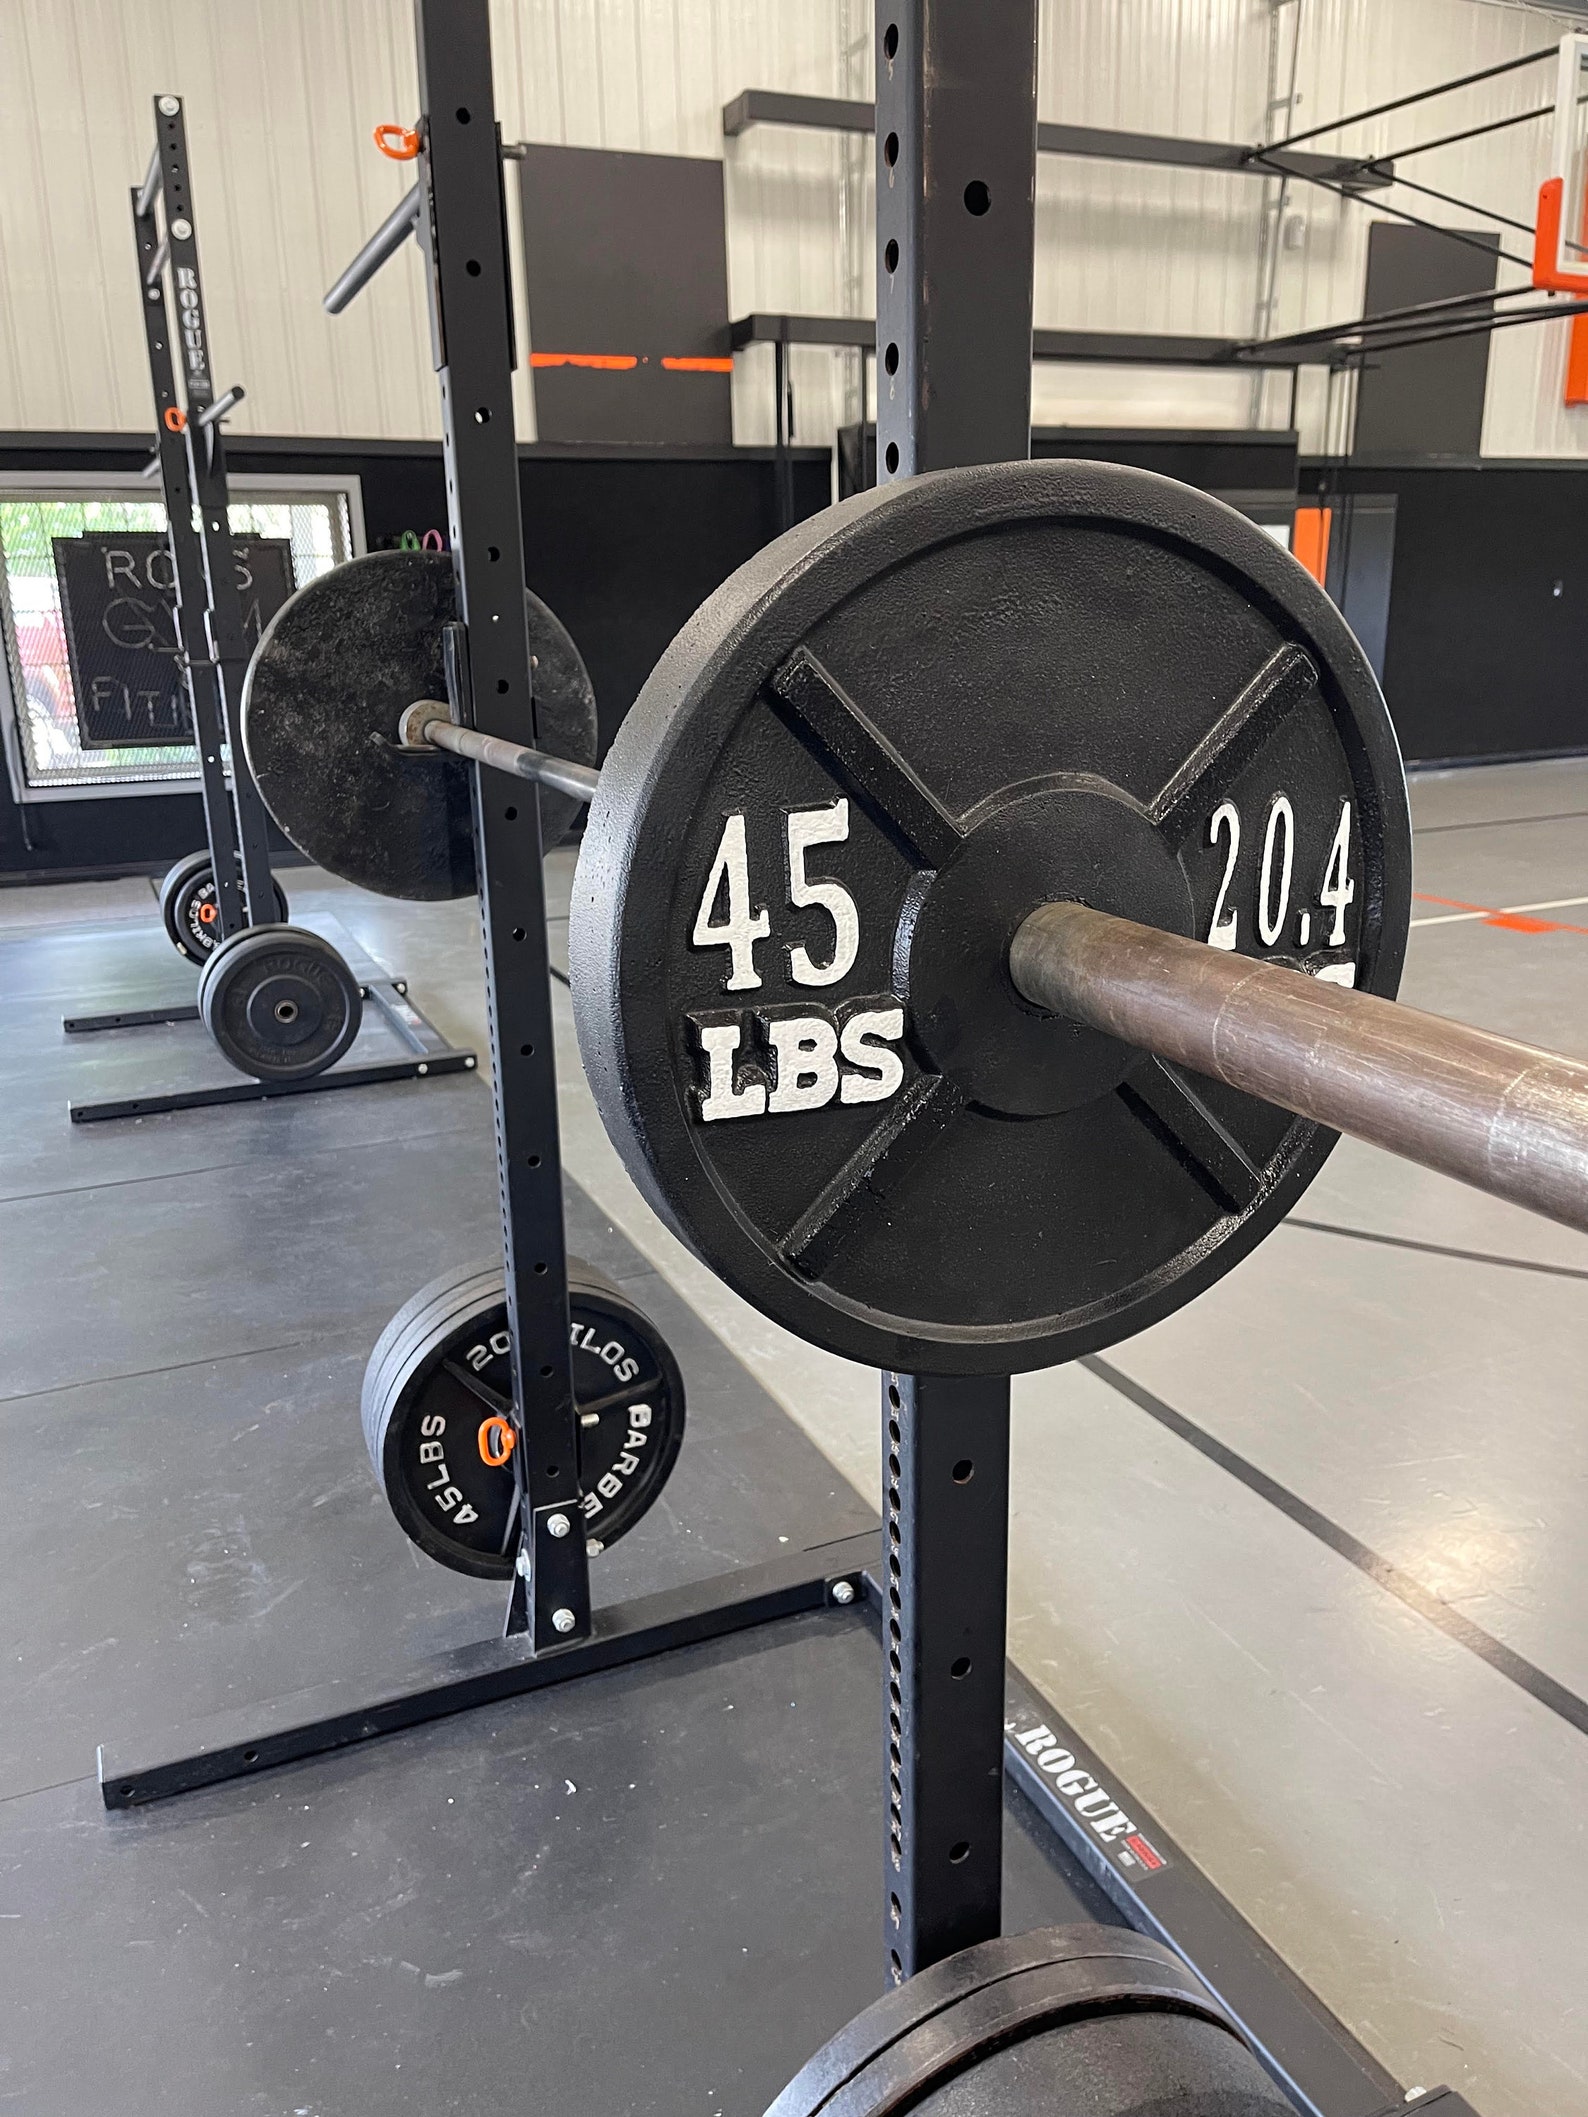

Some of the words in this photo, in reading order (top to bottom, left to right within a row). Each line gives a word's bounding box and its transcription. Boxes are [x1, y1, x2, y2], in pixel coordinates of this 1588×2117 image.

[177, 267, 206, 371] ROGUE
[693, 797, 859, 991] 45
[1207, 796, 1355, 951] 20.4
[699, 1009, 904, 1122] LBS
[568, 1322, 640, 1383] ILOS
[583, 1403, 653, 1519] BARBE
[1014, 1724, 1138, 1843] ROGUE
